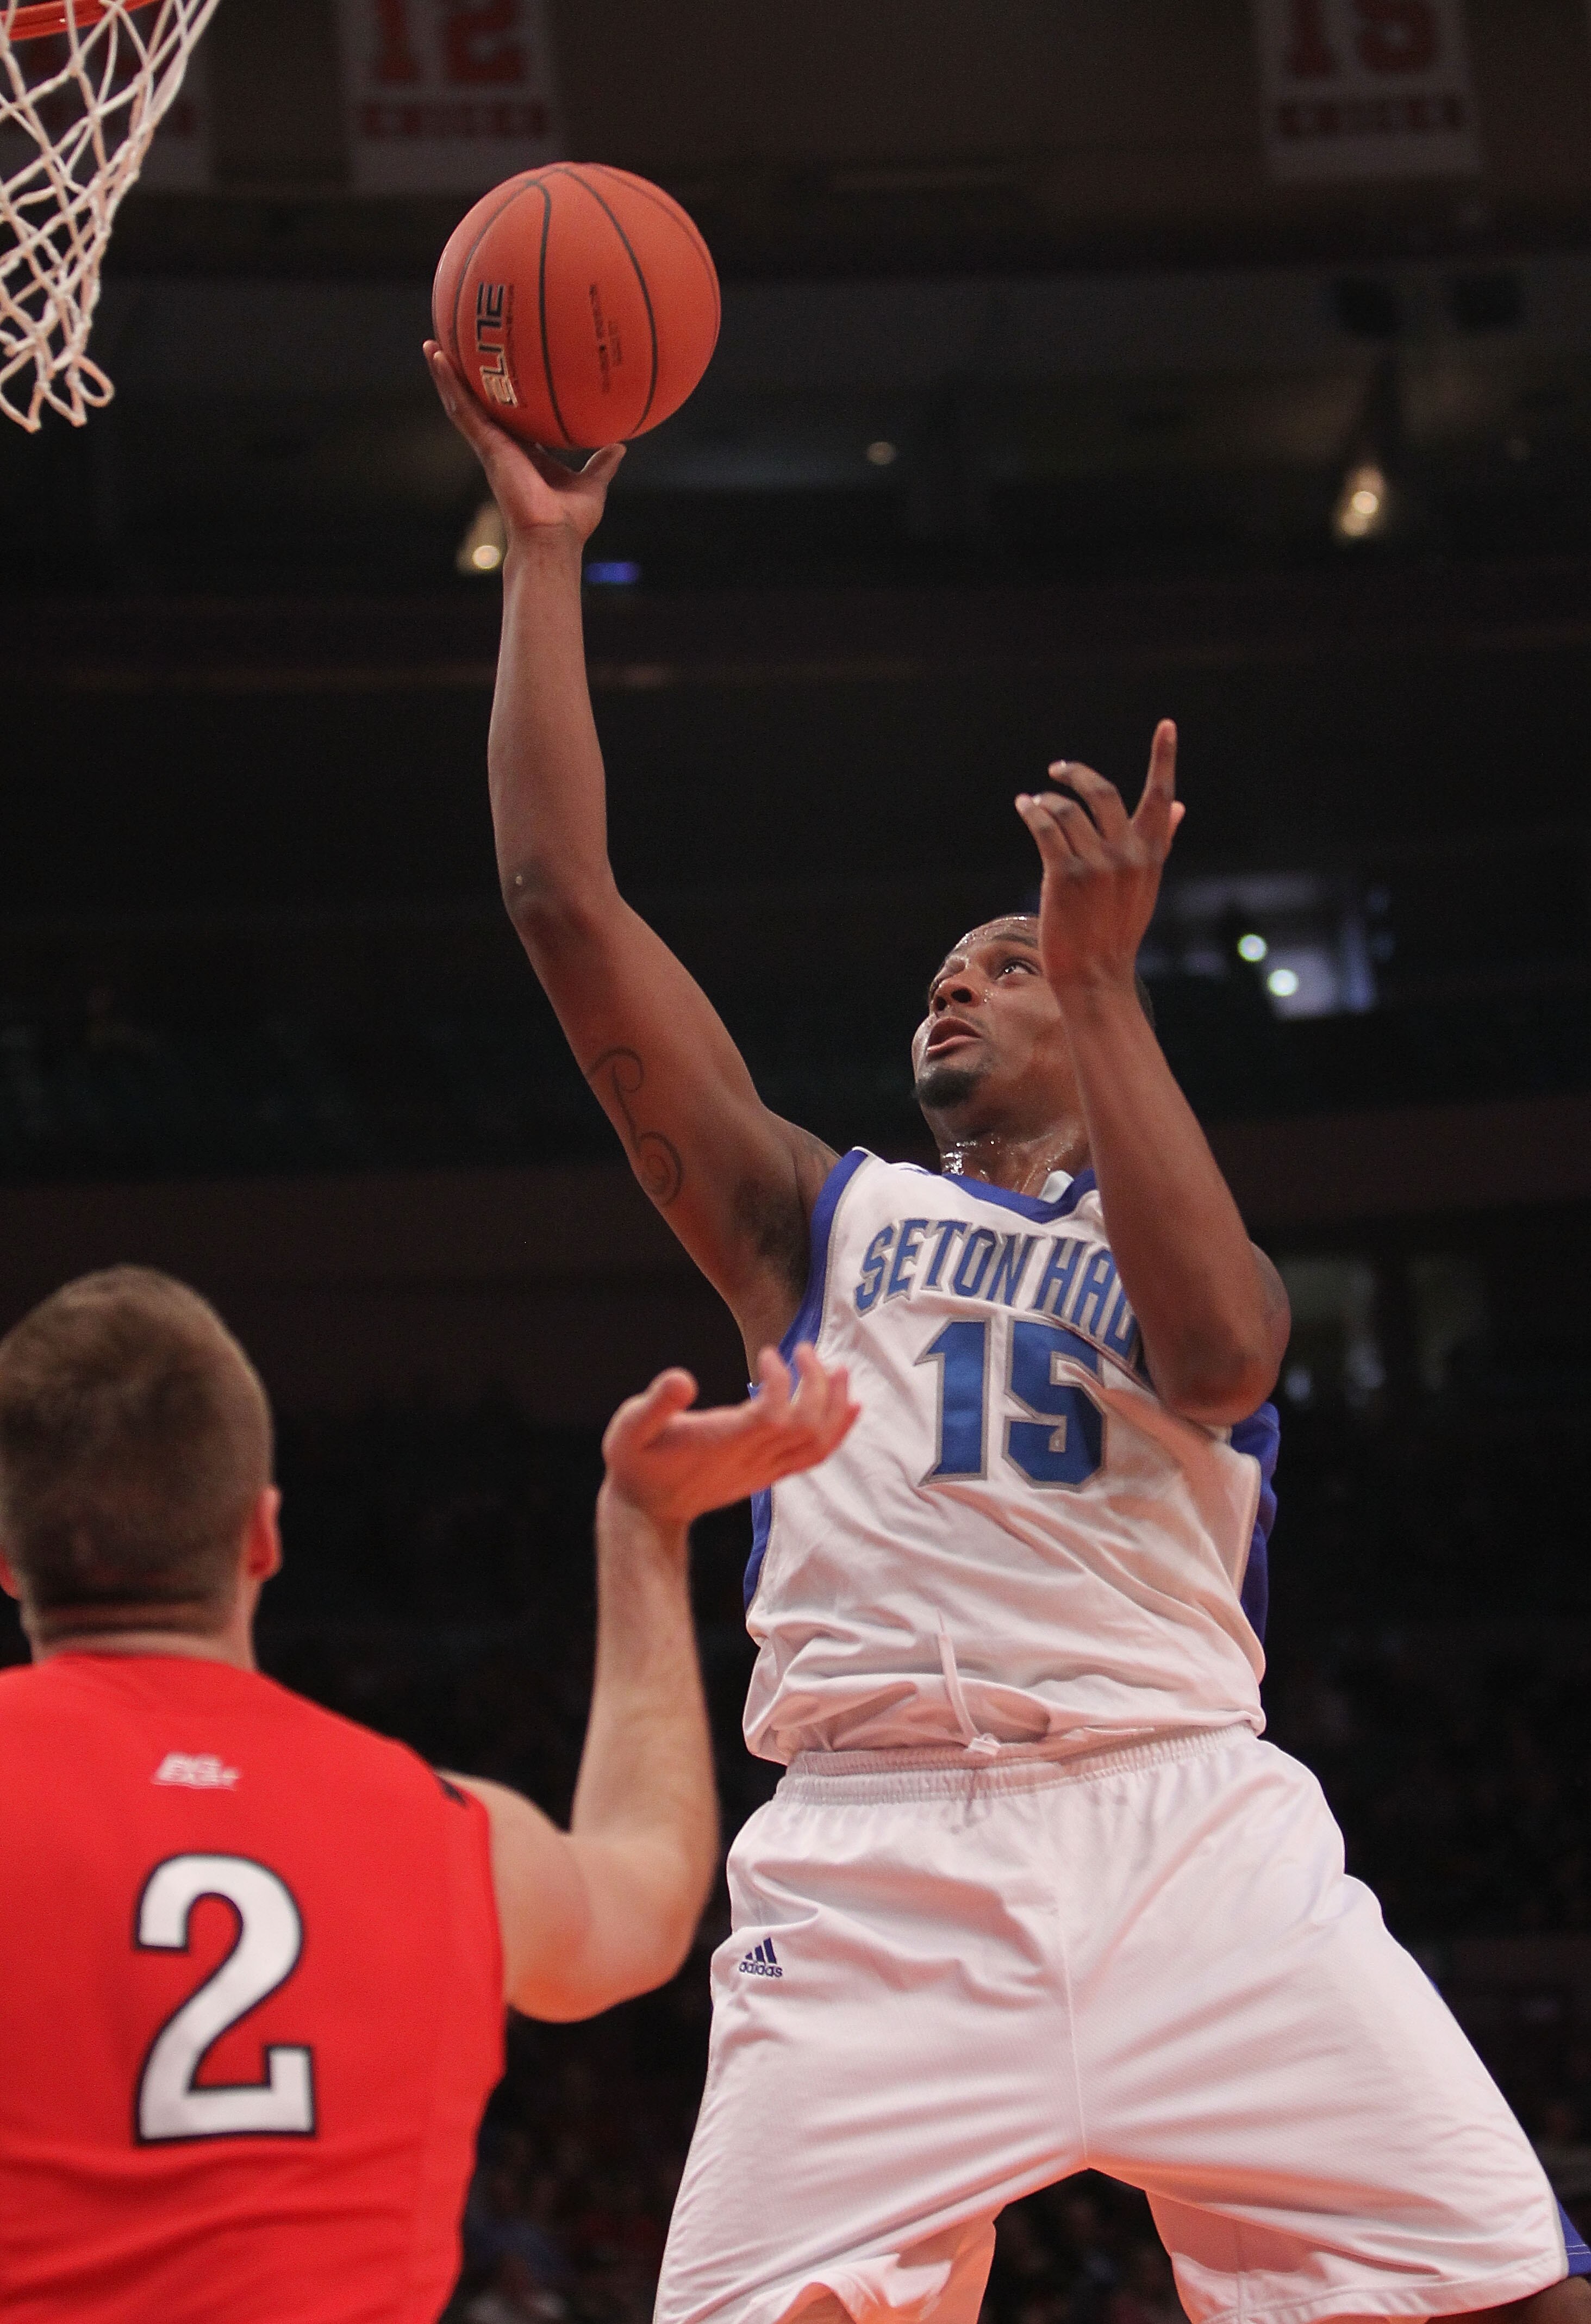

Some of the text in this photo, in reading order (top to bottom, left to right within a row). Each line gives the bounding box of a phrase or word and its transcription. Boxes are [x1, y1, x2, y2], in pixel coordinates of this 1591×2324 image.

[476, 283, 519, 409] ELITE
[853, 1219, 1037, 1316] SETON
[914, 1317, 1108, 1492] 15
[135, 1854, 316, 2144] 2
[739, 1961, 783, 1978] adidas
